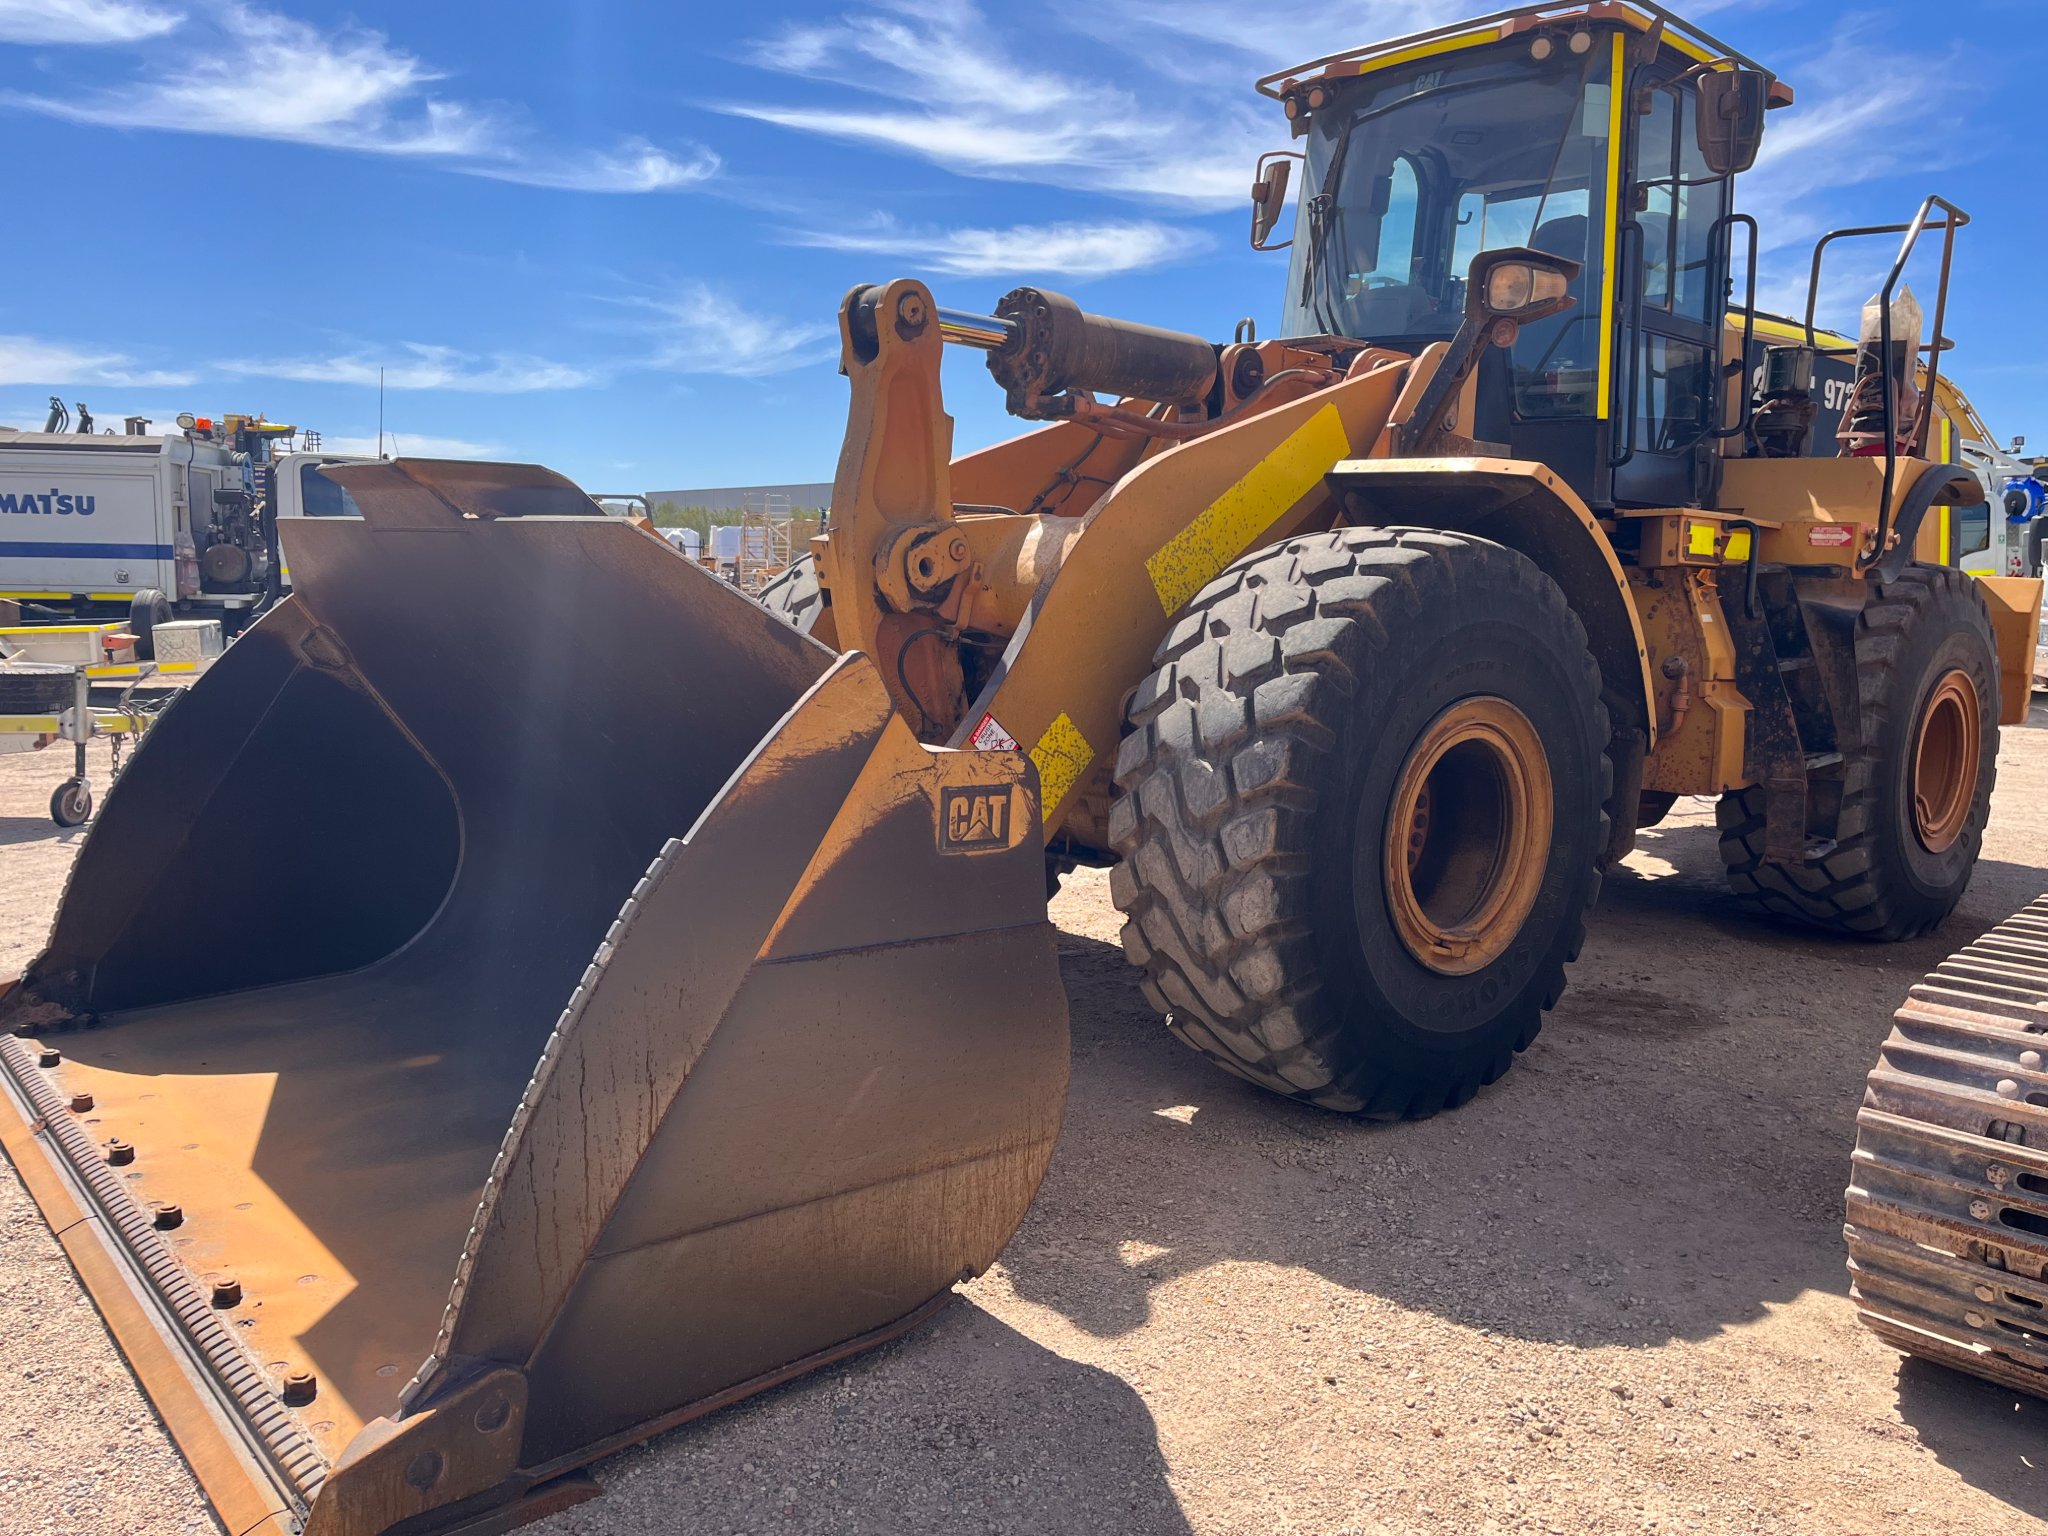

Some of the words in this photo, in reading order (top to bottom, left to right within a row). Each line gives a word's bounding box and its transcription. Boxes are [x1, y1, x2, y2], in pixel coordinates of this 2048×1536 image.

[1414, 70, 1445, 92] CAT
[978, 722, 993, 743] CRUSH
[983, 729, 996, 746] ZONE
[949, 795, 1007, 841] CAT
